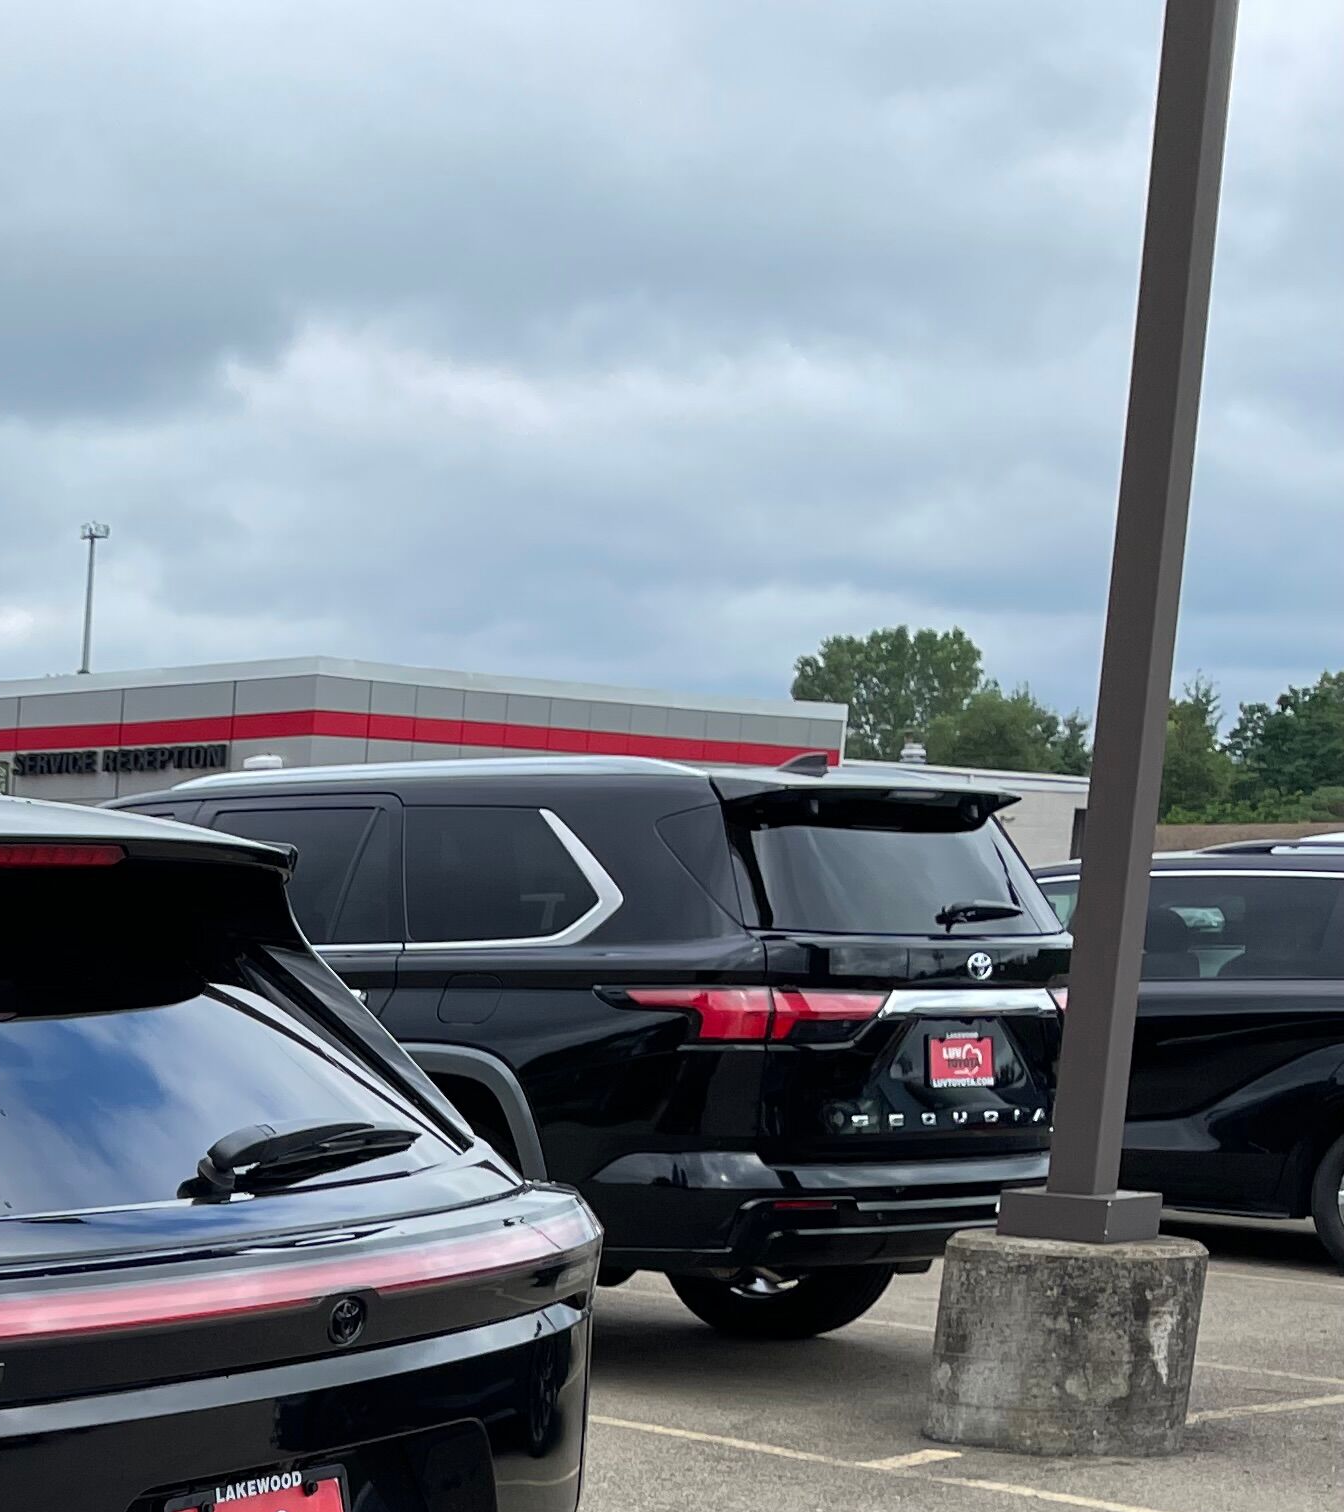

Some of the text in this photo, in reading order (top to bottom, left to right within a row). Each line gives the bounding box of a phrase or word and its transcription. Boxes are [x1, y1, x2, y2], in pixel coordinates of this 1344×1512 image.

[13, 744, 227, 776] SERVICE RECEPTION
[942, 1046, 962, 1060] LUV
[947, 1057, 981, 1069] TOYOTA
[932, 1077, 995, 1089] LUVTOYOTA.COM
[851, 1107, 1046, 1127] SEQUOIA
[215, 1470, 303, 1504] LAKEWOOD
